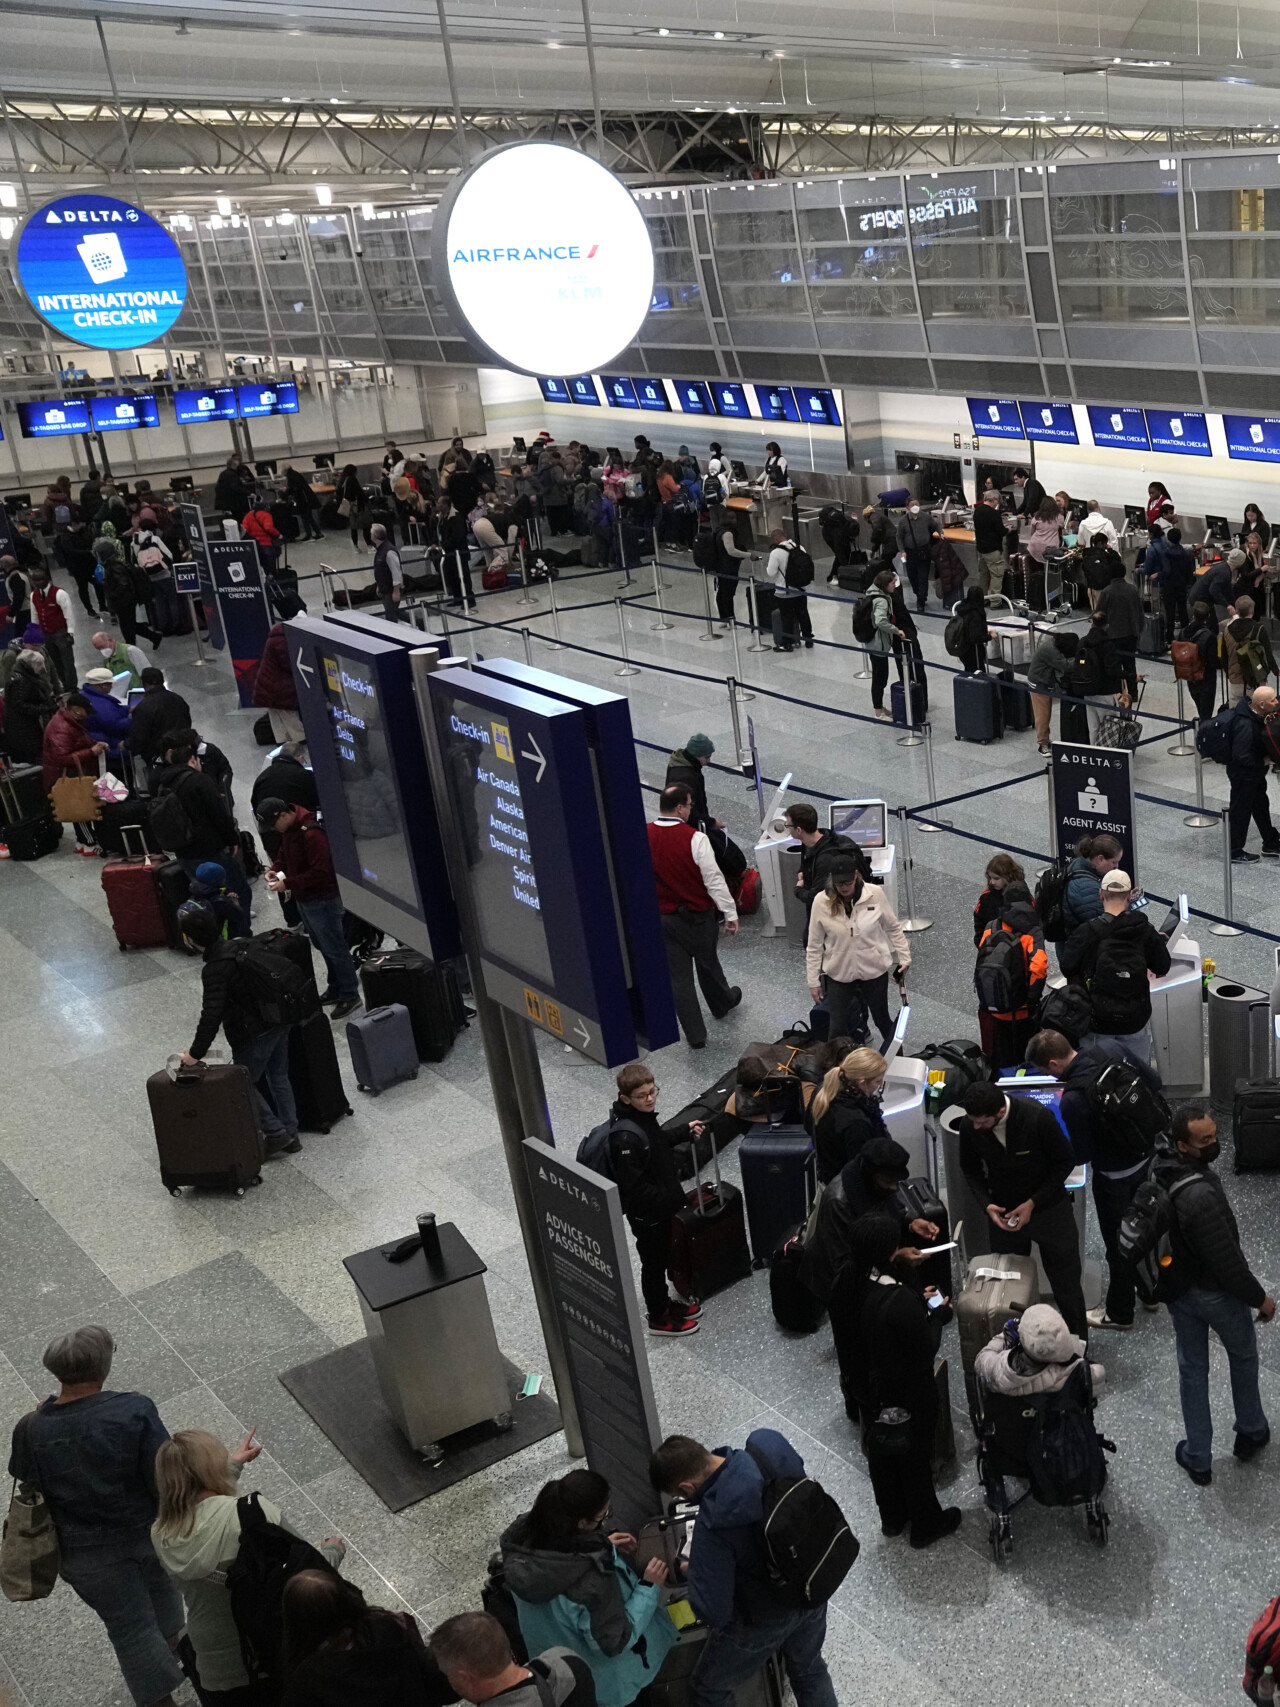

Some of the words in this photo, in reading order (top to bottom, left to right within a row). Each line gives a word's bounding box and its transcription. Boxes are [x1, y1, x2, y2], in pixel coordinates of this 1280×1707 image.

[64, 211, 122, 222] DELTA
[37, 290, 183, 310] INTERNATIONAL
[557, 287, 602, 299] KLM
[74, 309, 157, 327] CHECK-IN
[1095, 433, 1126, 441] INTERNATIONAL
[1152, 438, 1186, 447] INTERNATIONAL
[1230, 445, 1266, 454] INTERNATIONAL
[178, 573, 195, 581] EXIT
[341, 671, 375, 698] Check-in
[332, 705, 343, 720] Air
[343, 709, 365, 730] France
[336, 725, 354, 744] Delta
[451, 715, 491, 745] Check-in
[340, 745, 356, 762] KLM
[1072, 755, 1111, 768] DELTA
[477, 767, 489, 781] Air
[490, 772, 520, 797] Canada
[496, 797, 524, 820] Alaska
[490, 814, 528, 842] American
[1062, 816, 1094, 829] AGENT
[1095, 821, 1127, 834] ASSIST
[489, 834, 518, 859] Denver
[519, 848, 531, 865] Air
[513, 866, 537, 888] Spirit
[513, 885, 540, 910] United
[550, 1173, 589, 1205] DELTA
[546, 1211, 585, 1245] ADVICE
[584, 1235, 601, 1255] TO
[548, 1228, 613, 1279] PASSENGERS
